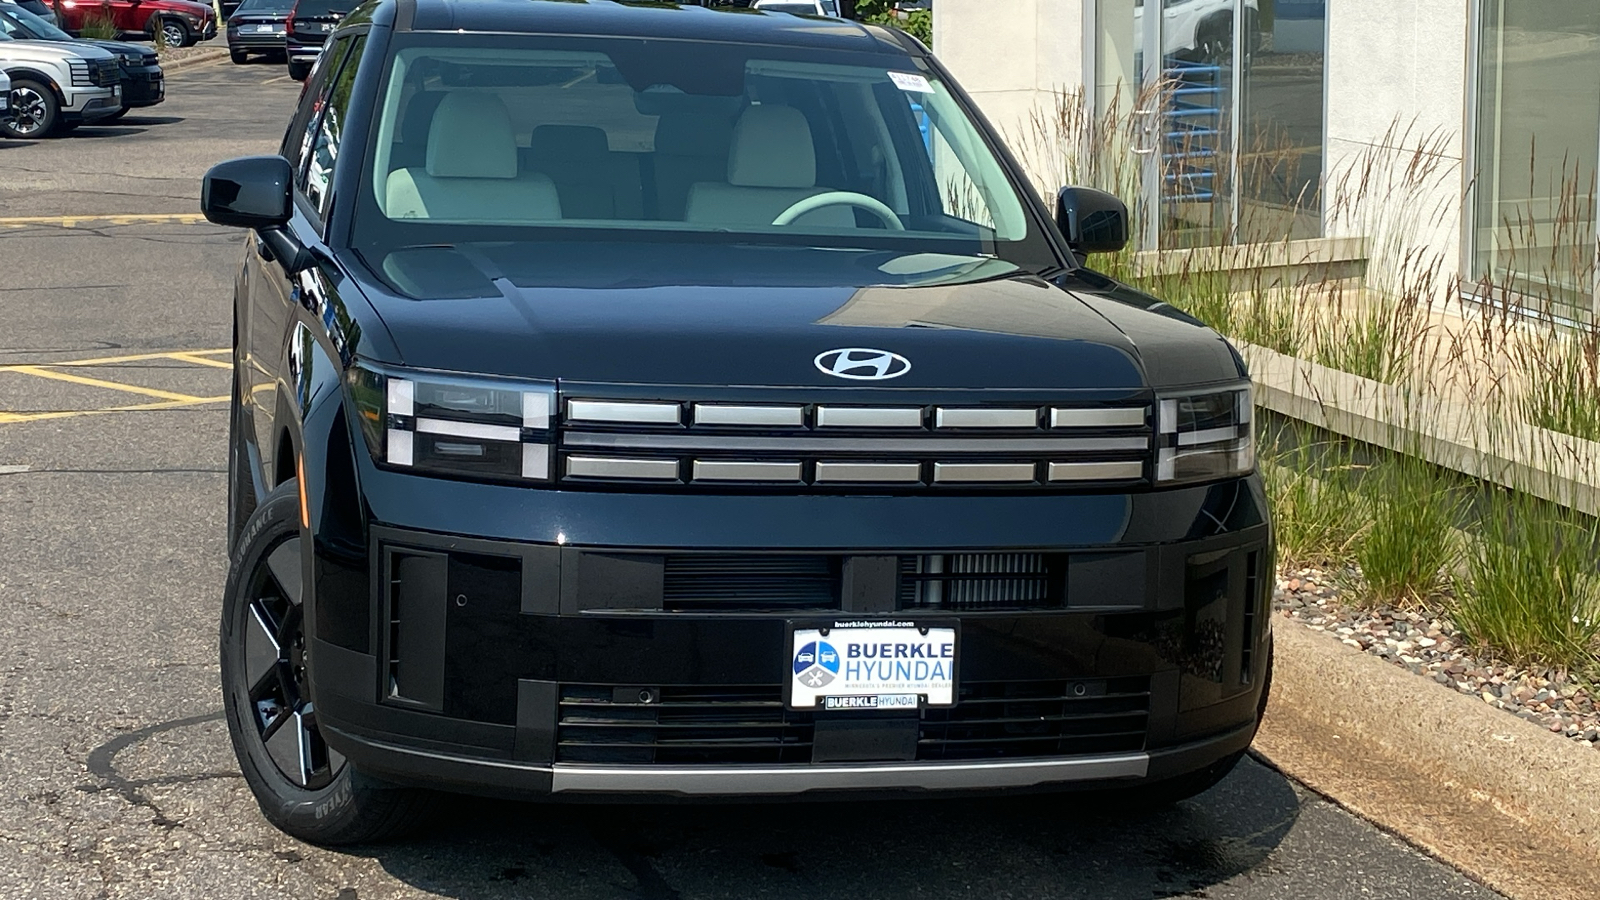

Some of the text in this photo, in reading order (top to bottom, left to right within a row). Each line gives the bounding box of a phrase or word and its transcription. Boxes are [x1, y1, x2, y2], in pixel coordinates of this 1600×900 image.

[231, 507, 273, 586] ASSURANCE
[834, 620, 914, 629] buerklehyundai.com
[847, 643, 953, 658] BUERKLE
[845, 660, 953, 681] HYUNDAI
[827, 696, 916, 708] BUERKLE HYUNDAI
